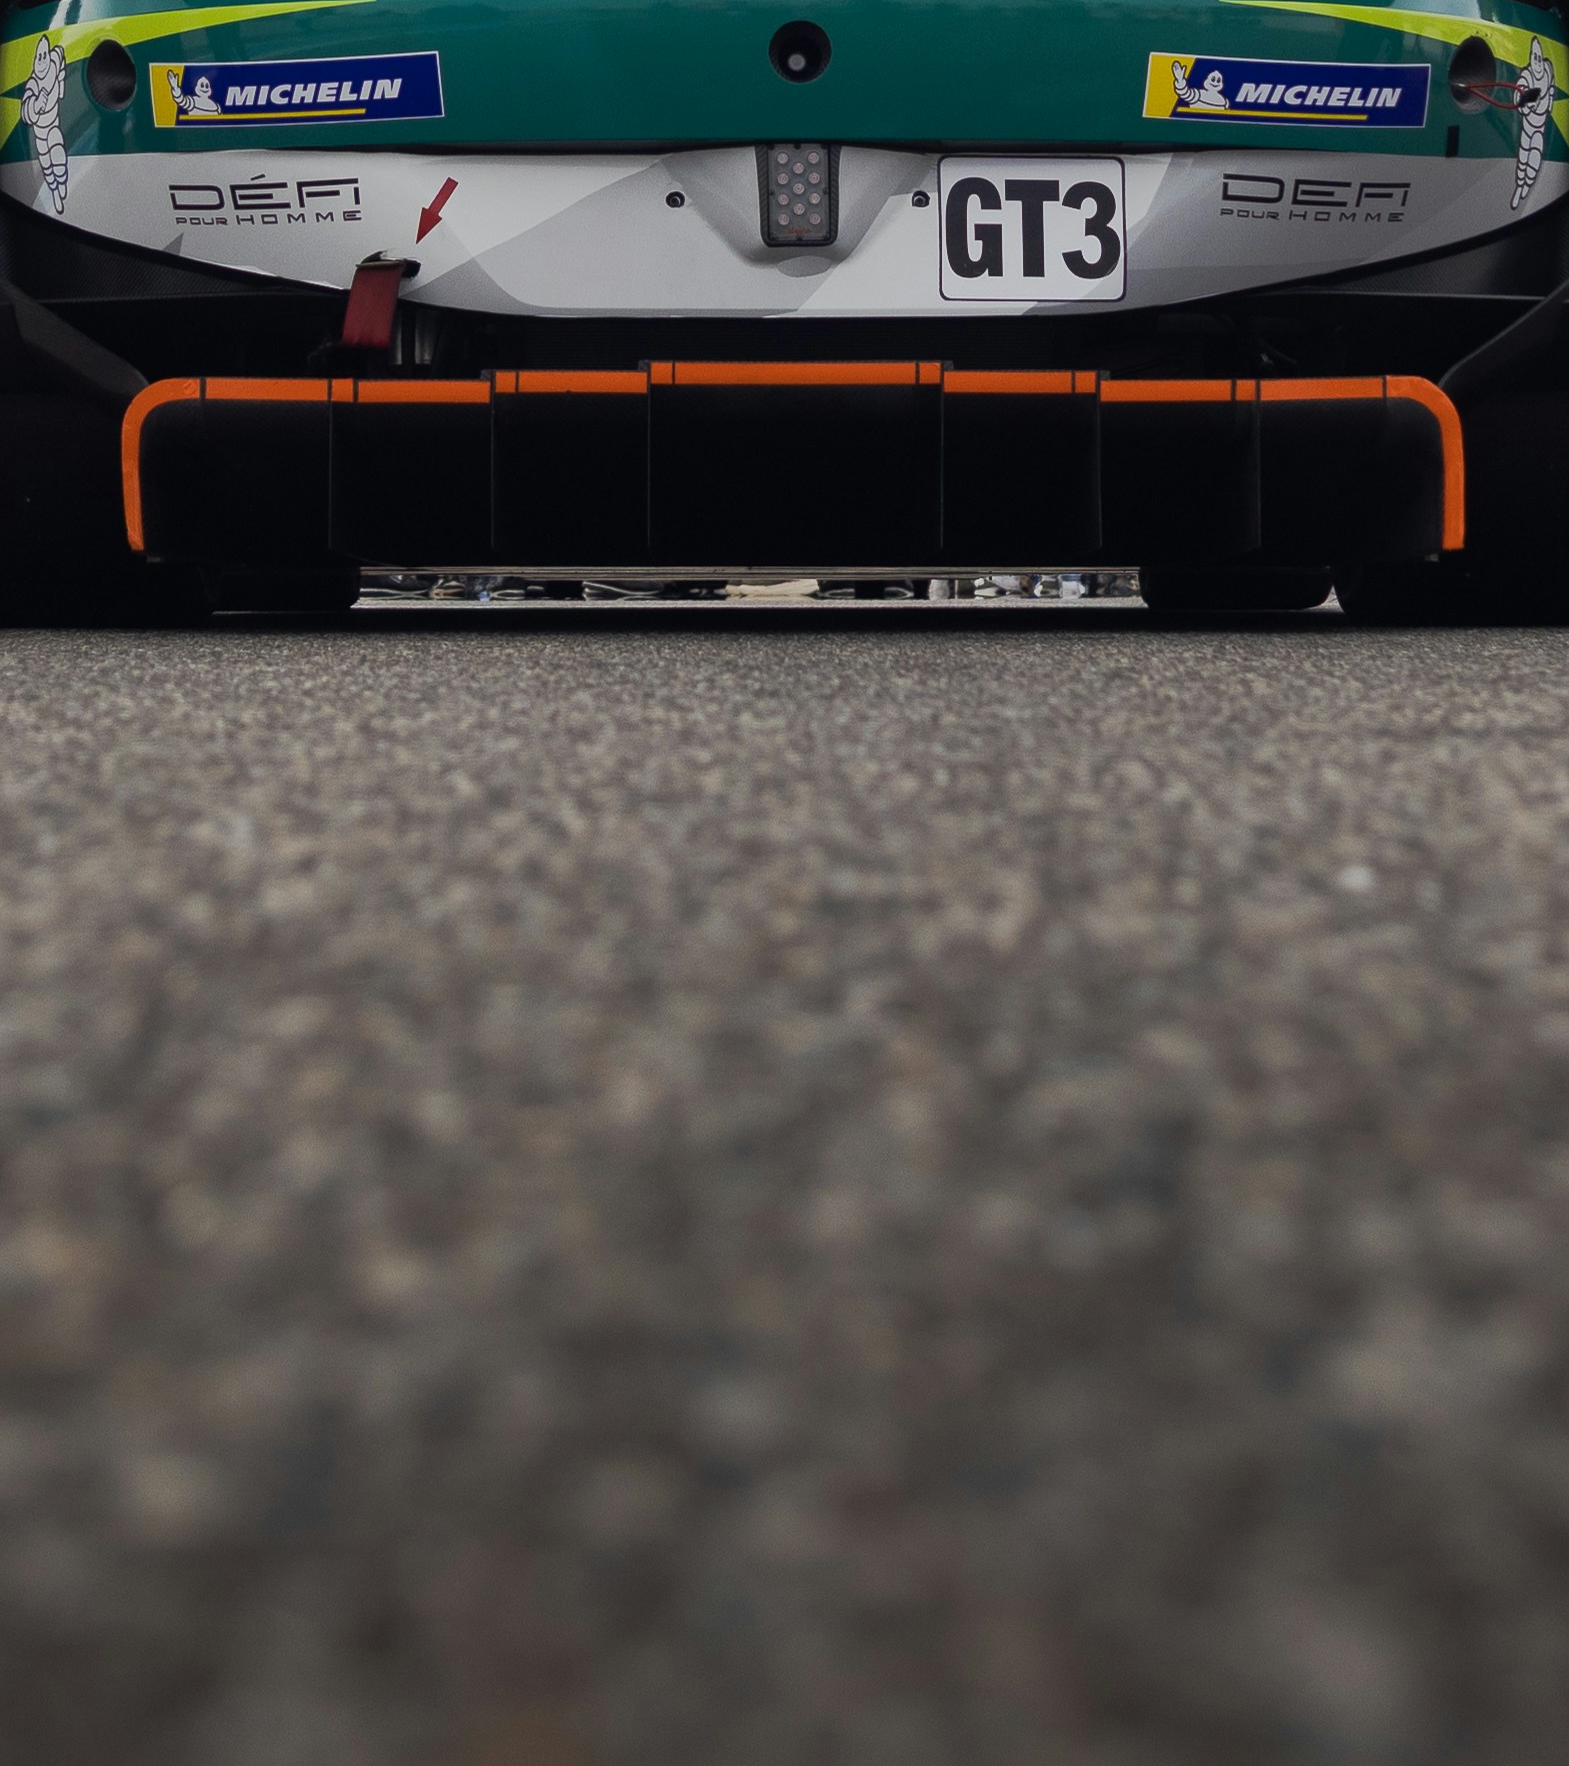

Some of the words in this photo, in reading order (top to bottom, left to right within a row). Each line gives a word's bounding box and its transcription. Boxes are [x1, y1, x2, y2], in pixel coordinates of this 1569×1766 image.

[225, 78, 403, 107] MICHELIN
[1235, 83, 1402, 107] MICHELIN
[168, 173, 361, 211] DÉFI
[175, 216, 228, 226] POUR
[236, 210, 362, 226] HOMME
[945, 176, 1121, 280] GT3
[1220, 207, 1280, 221] POUR
[1289, 209, 1405, 223] HOMME
